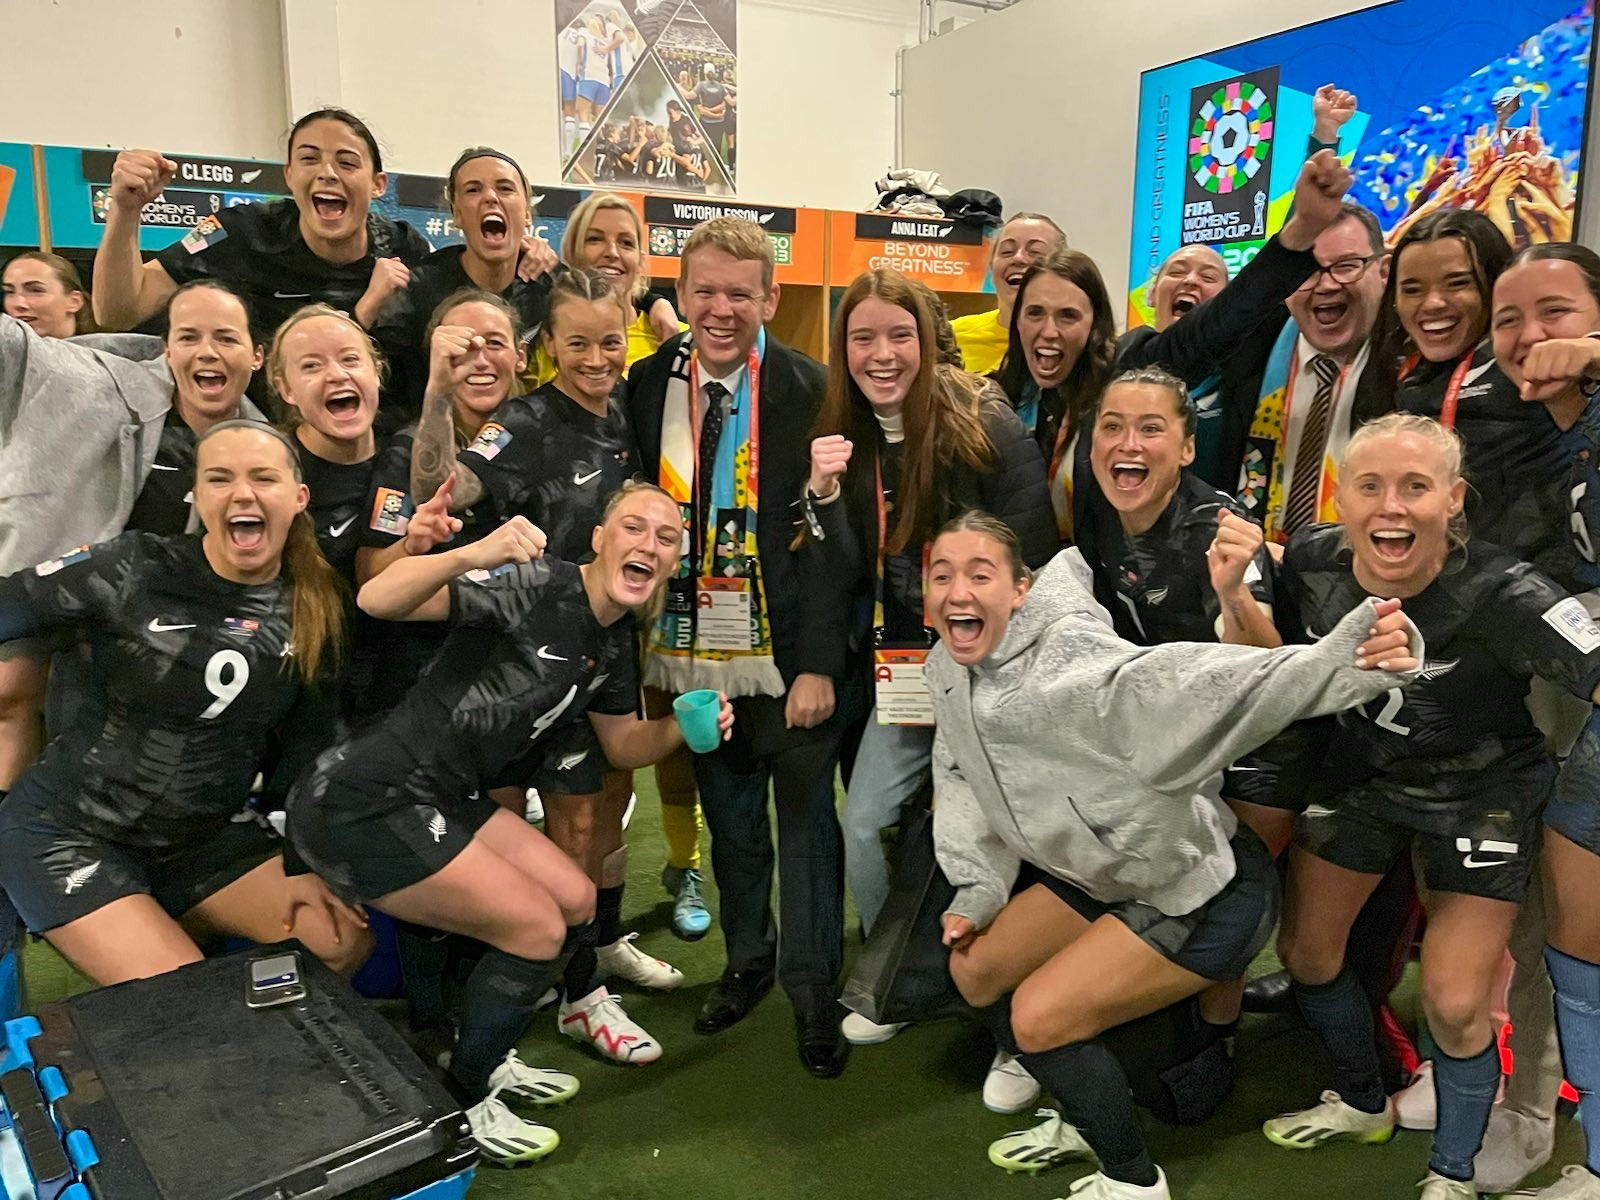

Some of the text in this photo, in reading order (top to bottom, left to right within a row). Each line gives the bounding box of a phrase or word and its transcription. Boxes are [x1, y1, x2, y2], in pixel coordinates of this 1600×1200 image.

[656, 156, 676, 178] 20
[1151, 94, 1171, 222] GREATNESS
[181, 163, 234, 183] CLEGG
[672, 203, 722, 220] VICTORIA
[1184, 200, 1215, 218] FIFA
[891, 221, 940, 238] ANNA LEAT
[1183, 211, 1241, 231] WOMEN'S
[1182, 223, 1252, 244] WORLD CUP
[884, 240, 950, 259] BEYOND
[200, 649, 250, 720] 9
[529, 684, 579, 740] 4
